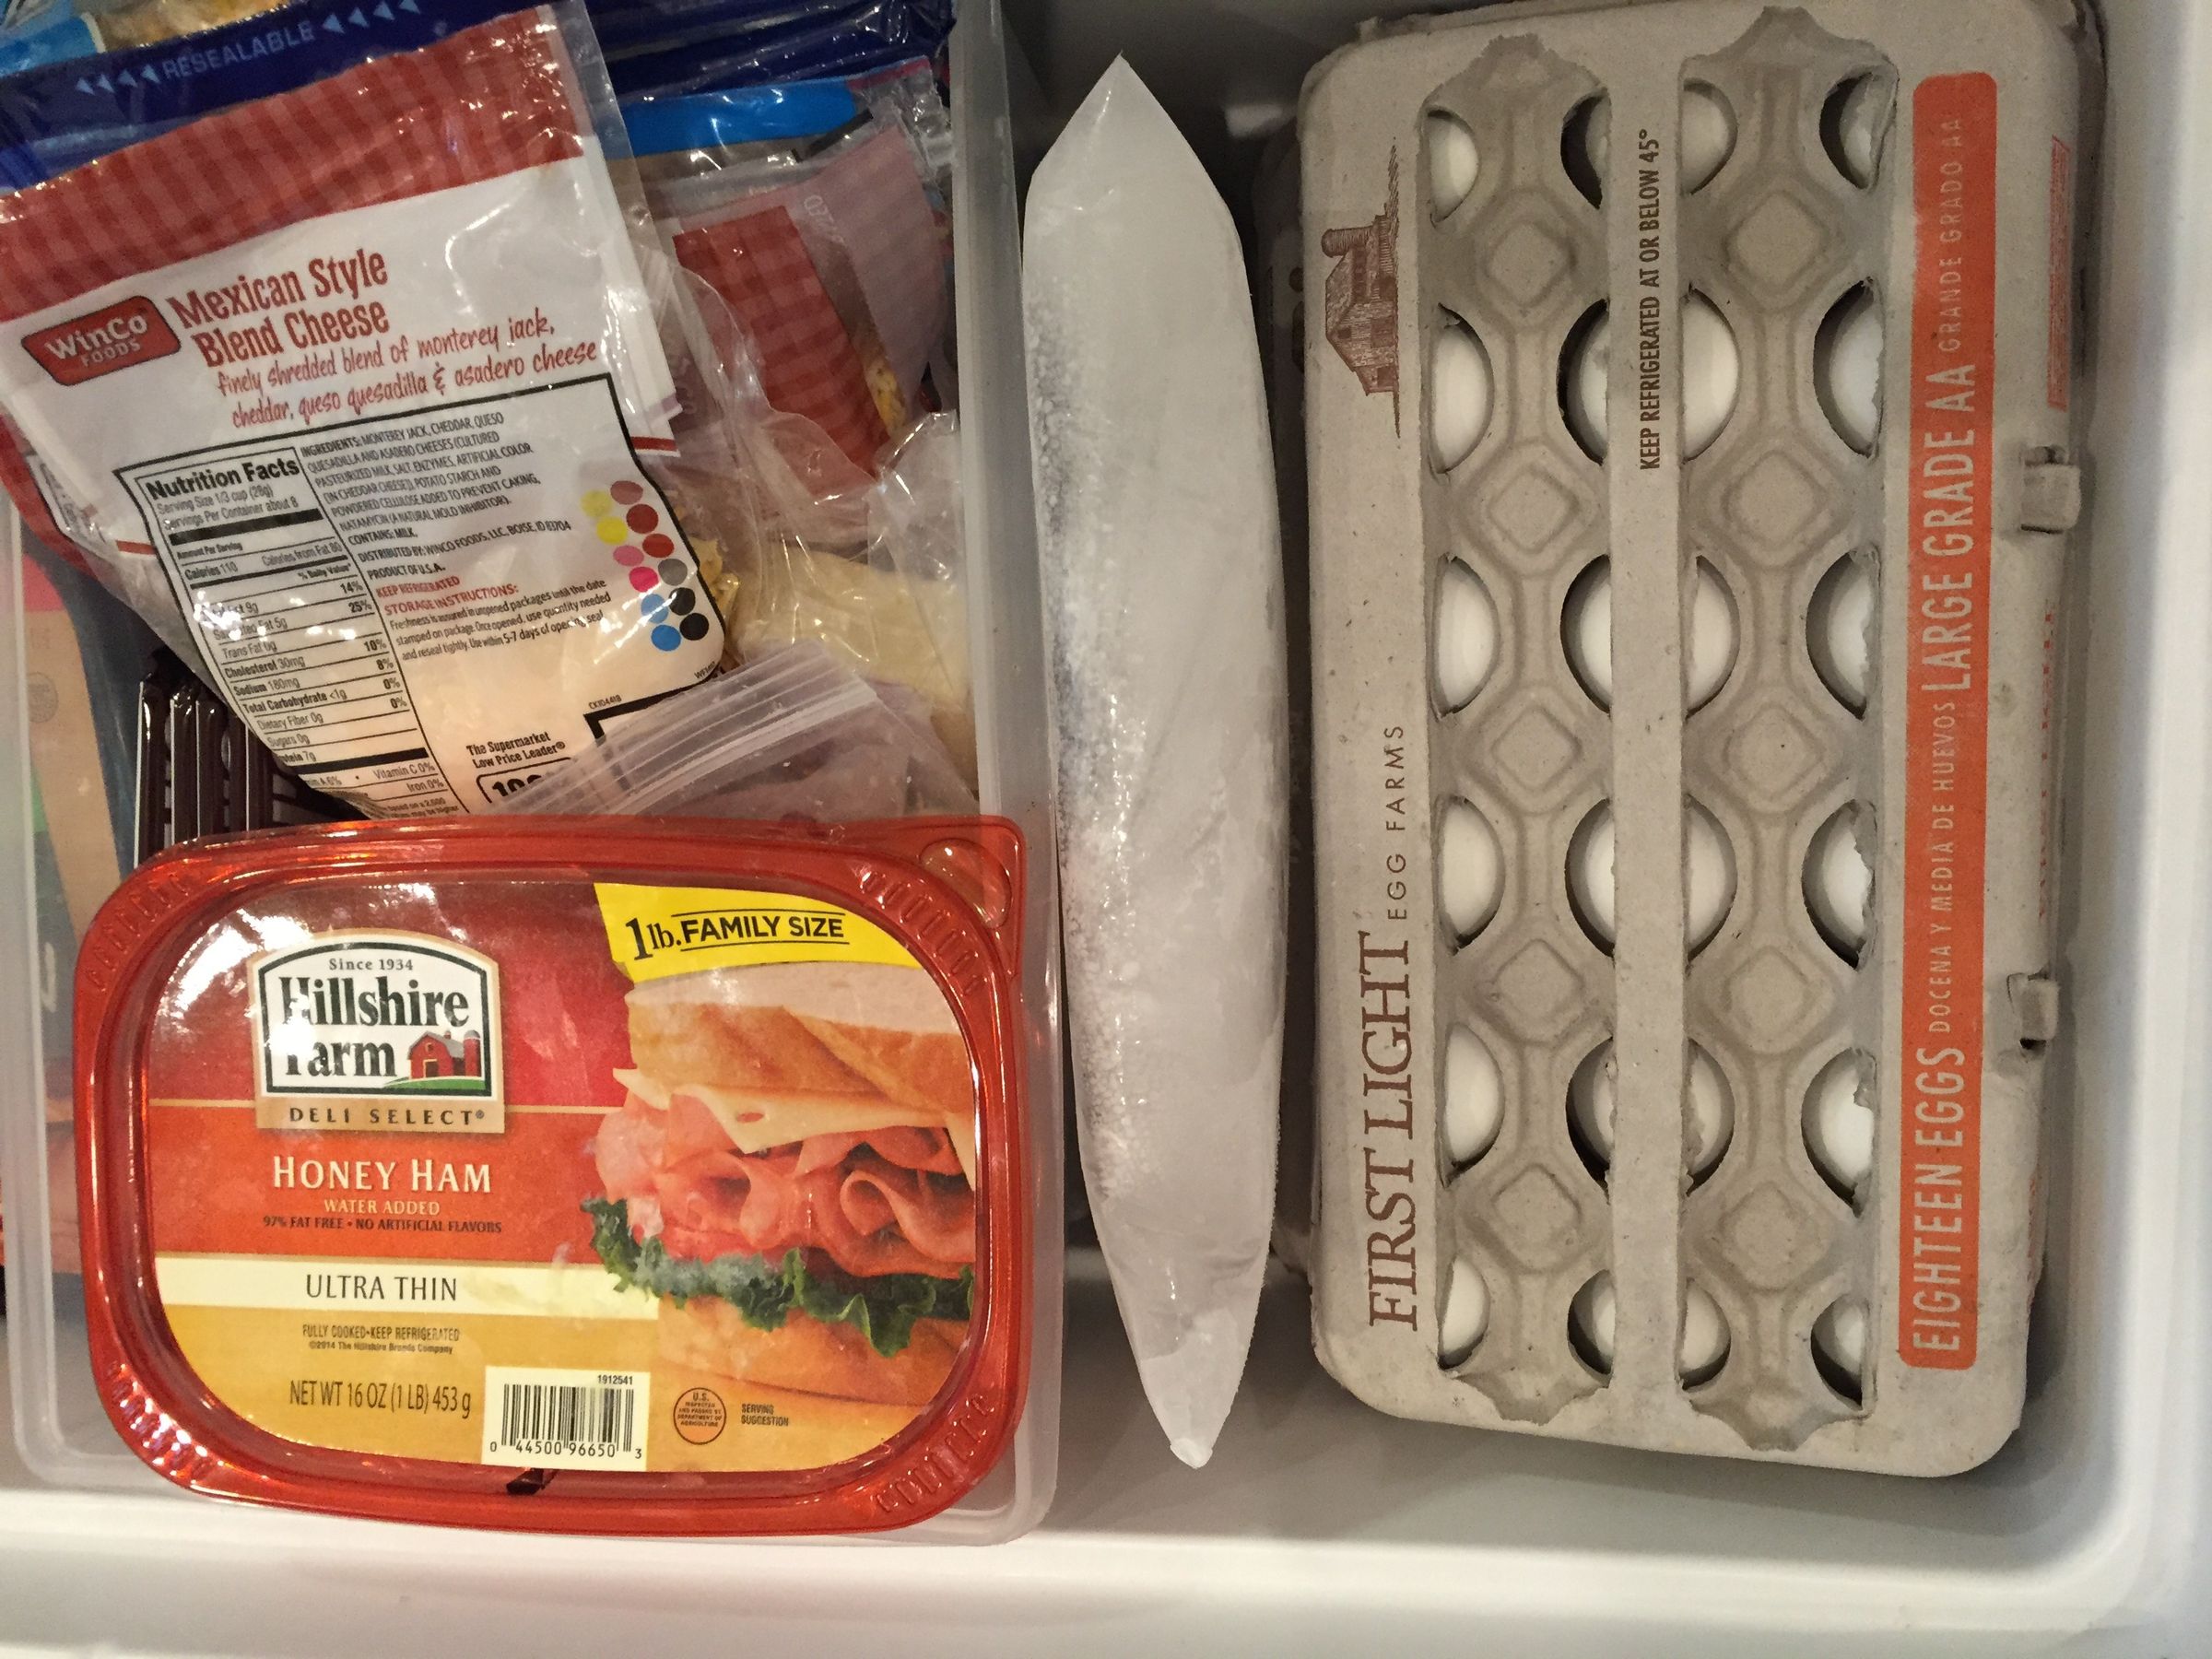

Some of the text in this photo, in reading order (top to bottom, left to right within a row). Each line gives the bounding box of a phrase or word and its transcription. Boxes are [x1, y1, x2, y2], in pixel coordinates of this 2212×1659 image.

[163, 20, 315, 81] RESEALABLE
[1938, 117, 1963, 352] GRANDE GRADO AA
[165, 248, 388, 329] Mexican Style
[1639, 128, 1660, 470] KEEP REFRIGERATED AT OR BELOW 45°
[44, 315, 147, 359] WinCo
[192, 301, 389, 368] Blend Cheese
[81, 341, 141, 367] FOODS
[218, 307, 554, 396] finely shredded blend of monterey jack,
[231, 341, 596, 429] cheddar, queso quesadilla & asadero cheese
[474, 412, 504, 428] QUESO
[415, 438, 453, 454] CHEESES
[456, 442, 534, 465] ARTIFICIAL COLOR
[146, 458, 300, 500] Nutrition Facts
[414, 465, 501, 488] POTATO STARCH AND
[447, 481, 502, 500] TO PREVENT
[432, 506, 459, 518] MOLD
[1922, 363, 1976, 692] LARGE GRADE AA
[358, 540, 456, 562] DISTRIBUTED WINCO
[185, 561, 238, 581] Calories 110
[367, 566, 406, 580] PRODUCT
[407, 564, 418, 575] OF
[340, 581, 363, 594] 14%
[376, 585, 398, 598] KEEP
[245, 602, 259, 613] 9g
[348, 599, 371, 614] 25%
[384, 583, 519, 616] STORAGE INSTRUCTIONS:
[390, 580, 606, 631] Freshness packages the date
[396, 592, 611, 646] stamped on use quantity needed
[403, 609, 604, 661] and reseal 5-7 days seal
[223, 646, 248, 658] Trans
[364, 638, 386, 653] 10%
[224, 656, 306, 678] Cholesterol 30mg
[376, 659, 394, 671] 8%
[234, 677, 300, 696] Sodium 180mg
[383, 677, 400, 689] 0%
[243, 688, 347, 713] Total Carbohydrate <1g
[390, 697, 407, 710] 0%
[287, 712, 324, 726] Fiber 0g
[466, 731, 551, 756] The Supermarket
[373, 760, 435, 780] Vitamin C 0%
[472, 759, 495, 769] Low
[495, 752, 523, 765] Price
[406, 779, 444, 794] Iron 0%
[1385, 725, 1407, 923] EGG FARMS
[1928, 701, 1955, 1033] DOCENA Y MEDIA DE HUEVOS
[680, 915, 781, 944] FAMILY
[788, 916, 844, 938] SIZE
[329, 959, 413, 971] Since 1934
[278, 976, 470, 1028] Hillshire
[289, 1107, 350, 1124] DELI
[1359, 930, 1418, 1332] FIRST LIGHT
[274, 1156, 491, 1194] HONEY HAM
[324, 1199, 440, 1216] WATER ADDED
[1912, 1048, 1965, 1351] EIGHTEEN EGGS
[264, 1217, 502, 1233] 97% FAT FREE NO ARTIFICIAL FLAVORS
[306, 1274, 457, 1300] ULTRA THIN
[302, 1324, 460, 1342] FULLY REFRIGERATED
[338, 1342, 351, 1350] The
[418, 1344, 453, 1354] Company
[597, 1374, 633, 1385] 1912541
[289, 1381, 471, 1419] NET WT 16 OZ (1 LB) 453 g
[693, 1393, 709, 1401] U.S.
[741, 1404, 774, 1415] SERVING
[741, 1416, 789, 1427] SUGGESTION
[490, 1441, 642, 1459] 0 44500 96650 3
